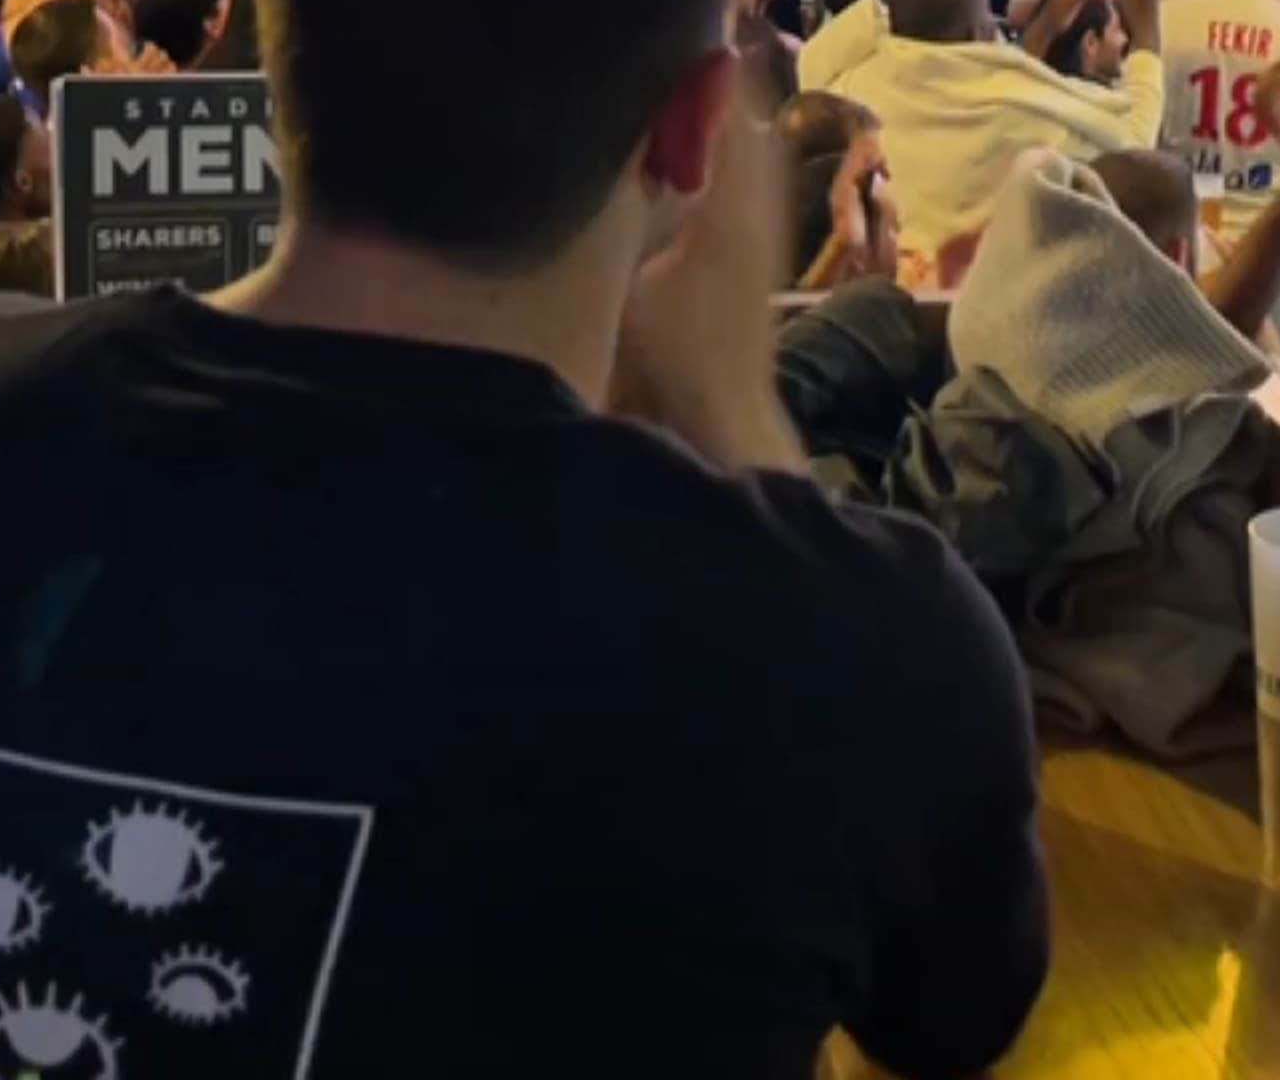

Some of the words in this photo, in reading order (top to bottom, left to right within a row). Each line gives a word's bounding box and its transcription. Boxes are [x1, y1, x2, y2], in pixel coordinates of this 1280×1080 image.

[1208, 20, 1273, 59] FEKIR
[1189, 66, 1274, 148] 18
[92, 125, 282, 196] MEN
[96, 225, 221, 250] SHARERS
